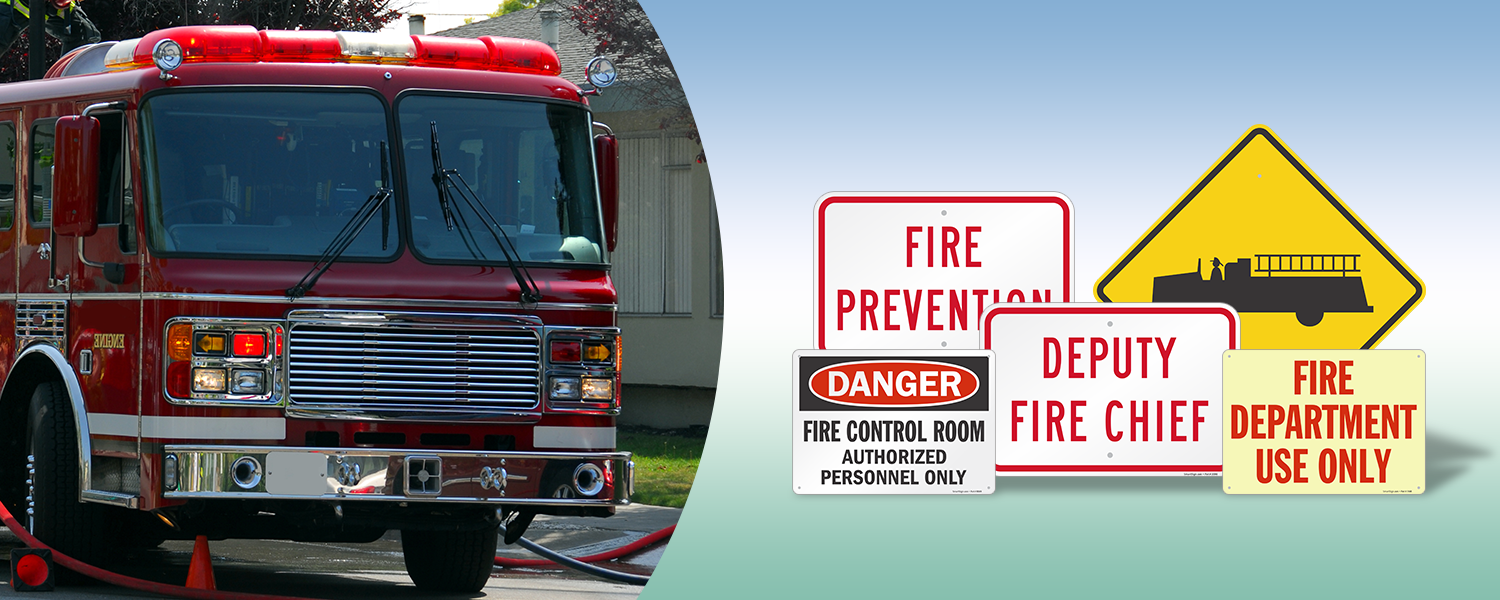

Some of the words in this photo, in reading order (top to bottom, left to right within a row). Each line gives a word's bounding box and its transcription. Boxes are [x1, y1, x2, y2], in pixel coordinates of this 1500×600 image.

[906, 226, 982, 267] FIRE
[1043, 337, 1176, 379] DEPUTY
[828, 371, 961, 397] DANGER
[1294, 360, 1354, 395] FIRE
[803, 420, 841, 442] FIRE
[846, 420, 927, 442] CONTROL
[933, 420, 985, 442] ROOM
[1011, 400, 1087, 442] FIRE
[1105, 400, 1209, 442] CHIEF
[1231, 405, 1417, 439] DEPARTMENT
[842, 449, 947, 465] AUTHORIZED
[1256, 448, 1308, 484] USE
[1318, 448, 1392, 484] ONLY
[821, 469, 919, 485] PERSONNEL
[924, 469, 967, 485] ONLY
